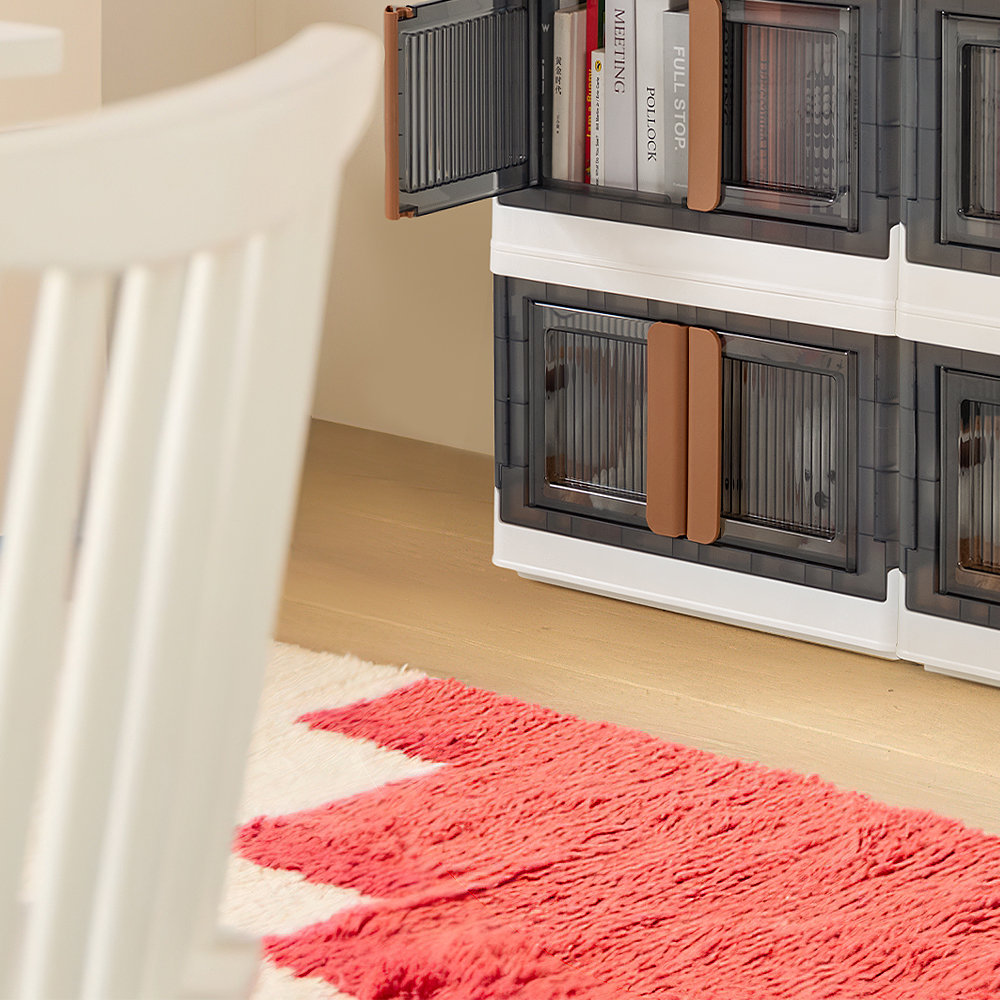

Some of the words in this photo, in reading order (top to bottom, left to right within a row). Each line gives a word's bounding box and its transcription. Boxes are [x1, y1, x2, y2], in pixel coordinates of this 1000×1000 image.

[614, 8, 625, 94] MEETING
[673, 46, 686, 93] FULL
[646, 86, 657, 161] POLLOCK
[674, 98, 686, 151] STOP.
